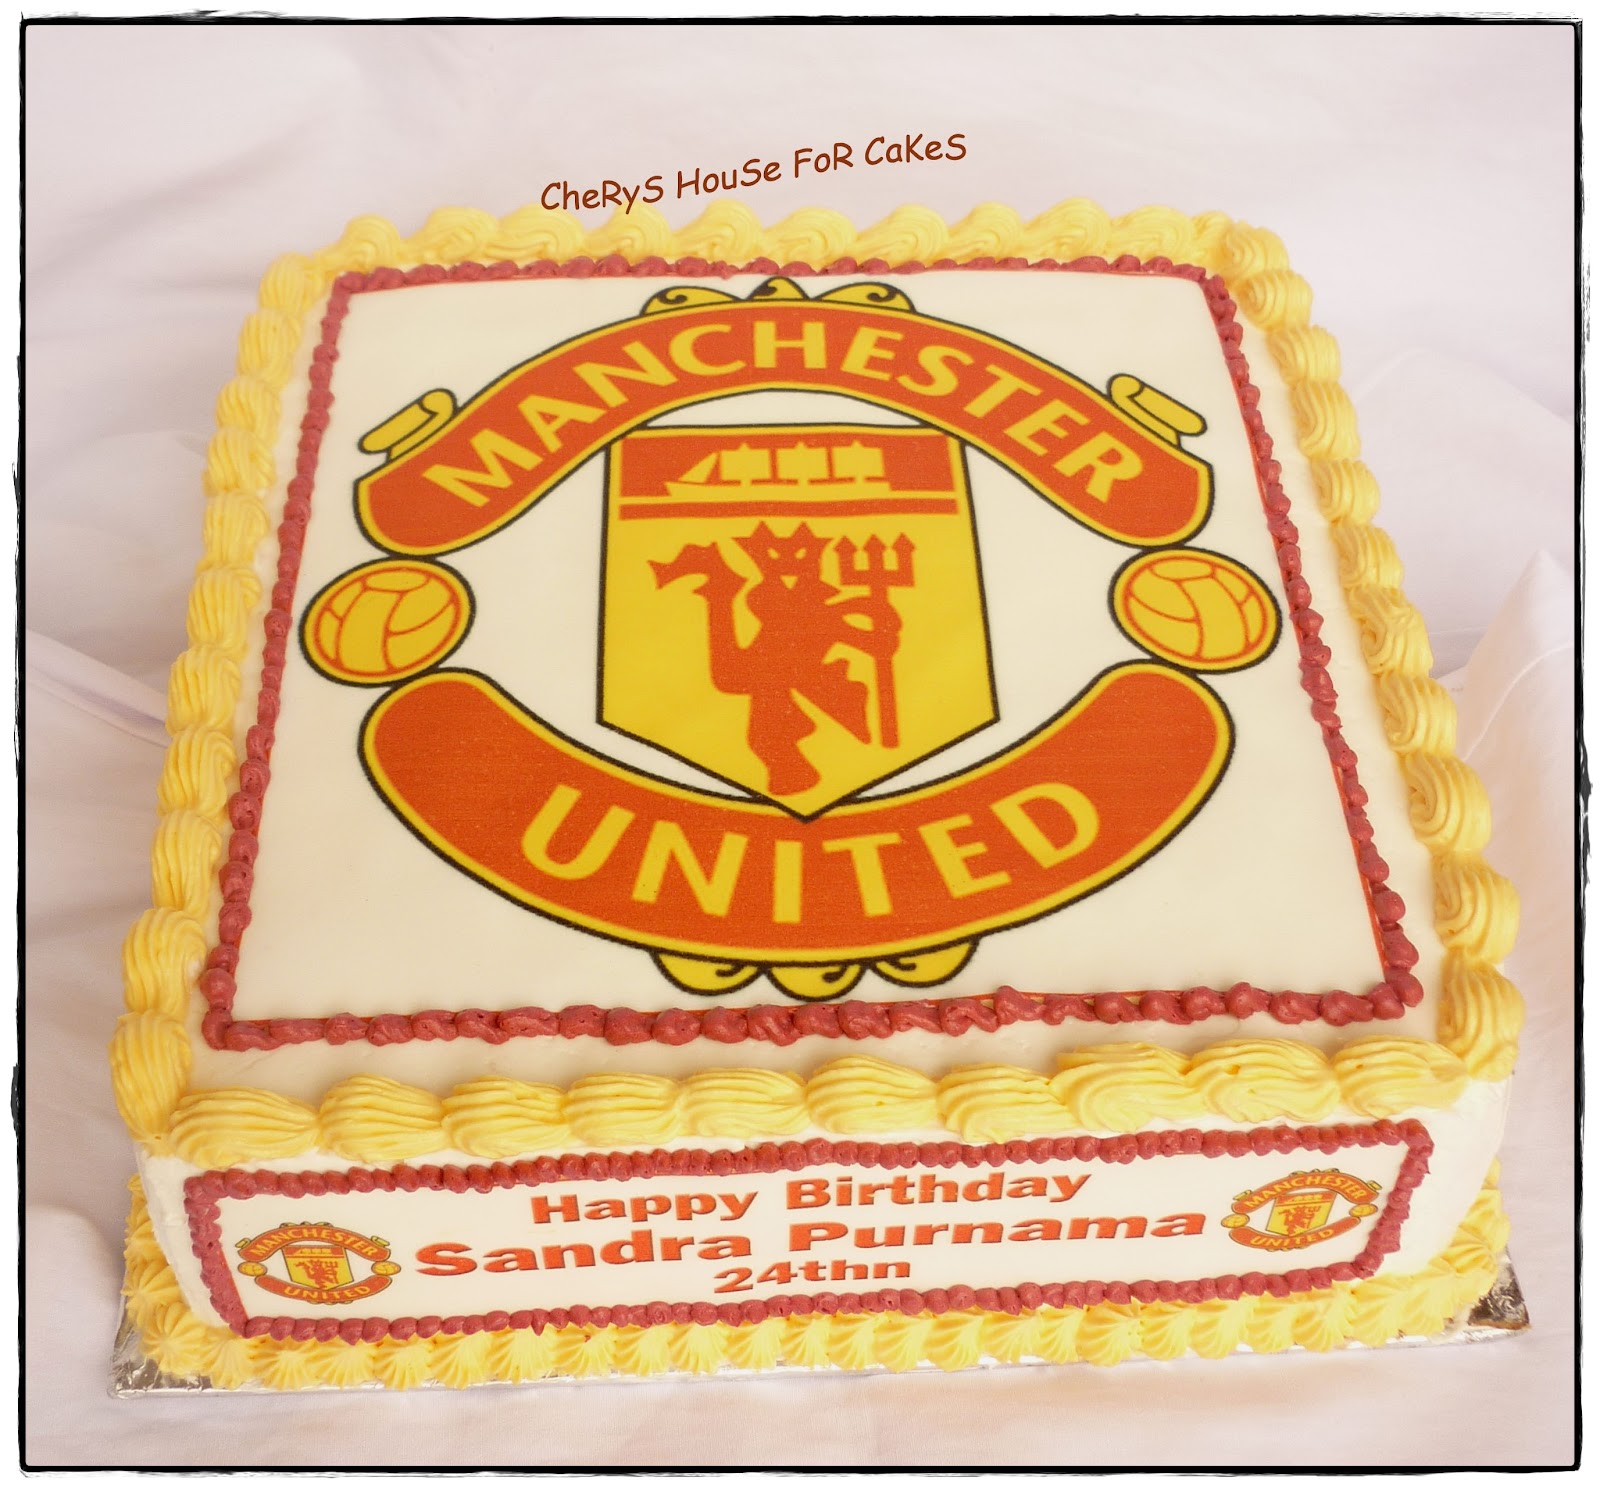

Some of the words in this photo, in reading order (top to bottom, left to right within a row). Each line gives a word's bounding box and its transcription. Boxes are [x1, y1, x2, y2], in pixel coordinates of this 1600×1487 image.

[420, 320, 1144, 508] MANCHESTER
[521, 781, 1100, 924] UNITED
[530, 1190, 759, 1225] Happy
[786, 1171, 1093, 1210] Birthday
[1244, 1173, 1367, 1209] MANCHESTER
[250, 1227, 379, 1257] MANCHESTER
[415, 1229, 752, 1276] Sandra
[788, 1212, 1207, 1251] Purnama
[1250, 1228, 1334, 1247] UNITED
[284, 1286, 371, 1300] UNITED
[713, 1259, 911, 1294] 24thn
